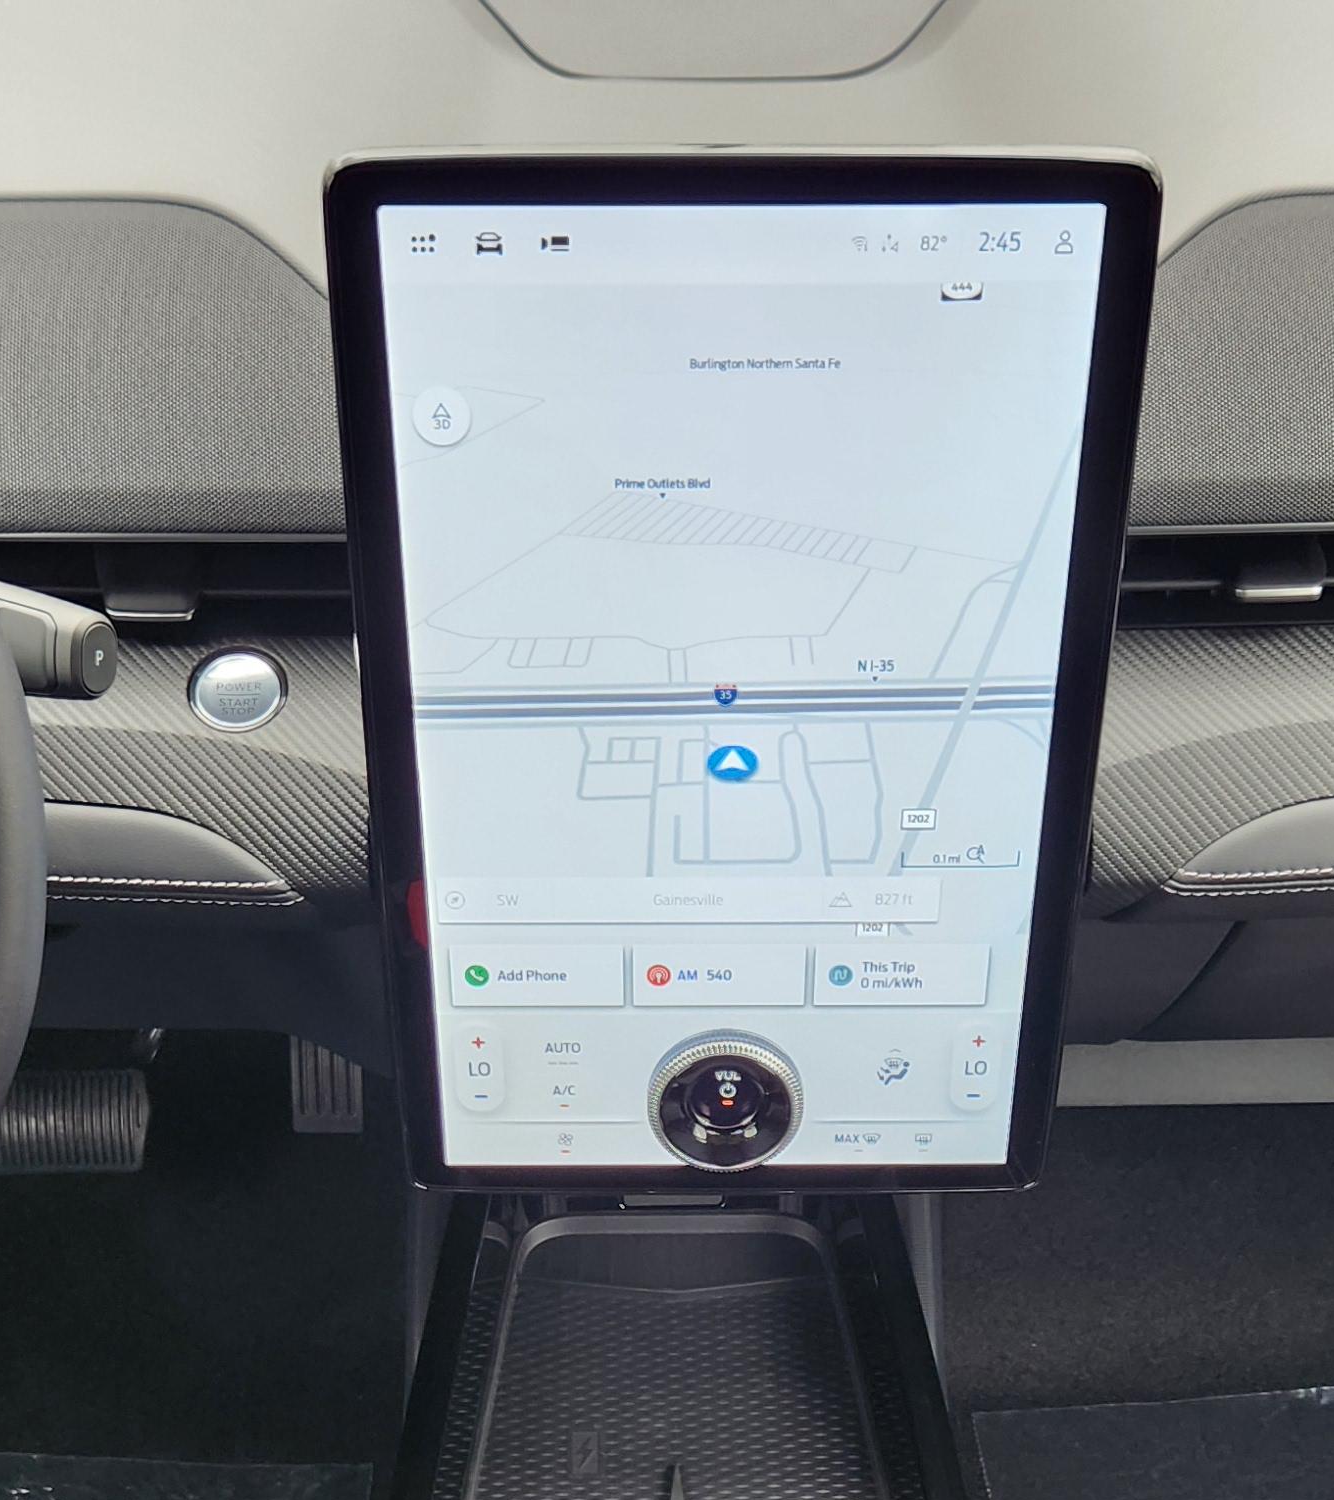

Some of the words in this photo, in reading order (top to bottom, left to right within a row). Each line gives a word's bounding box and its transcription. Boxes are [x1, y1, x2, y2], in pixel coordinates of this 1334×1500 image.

[920, 235, 947, 252] 82°
[978, 231, 1021, 252] 2:45
[689, 358, 745, 371] Burlington
[746, 358, 793, 370] Northern
[794, 358, 826, 370] Santa
[828, 358, 842, 370] Fe
[433, 418, 452, 431] 3D
[614, 478, 646, 490] Prime
[647, 478, 686, 490] Outlets
[687, 478, 711, 490] Blvd
[94, 650, 104, 666] P
[857, 660, 867, 672] N
[870, 660, 894, 672] I-35
[216, 682, 262, 692] POWER
[719, 690, 733, 700] 35
[219, 698, 259, 707] START
[221, 707, 255, 716] STOP
[907, 814, 930, 824] 1202
[932, 854, 947, 864] 0.1
[496, 894, 519, 907] SW
[653, 894, 724, 907] Gainesville
[874, 893, 900, 906] 827
[902, 893, 913, 906] ft
[862, 961, 889, 974] This
[890, 961, 916, 975] Trip
[497, 969, 523, 982] Add
[526, 969, 568, 982] Phone
[677, 969, 698, 982] AM
[706, 969, 733, 982] 540
[860, 977, 870, 989] 0
[872, 977, 923, 989] mi/kWh
[544, 1042, 582, 1054] AUTO
[468, 1061, 492, 1077] LO
[964, 1060, 988, 1076] LO
[552, 1084, 577, 1096] A/C
[834, 1133, 860, 1144] MAX
